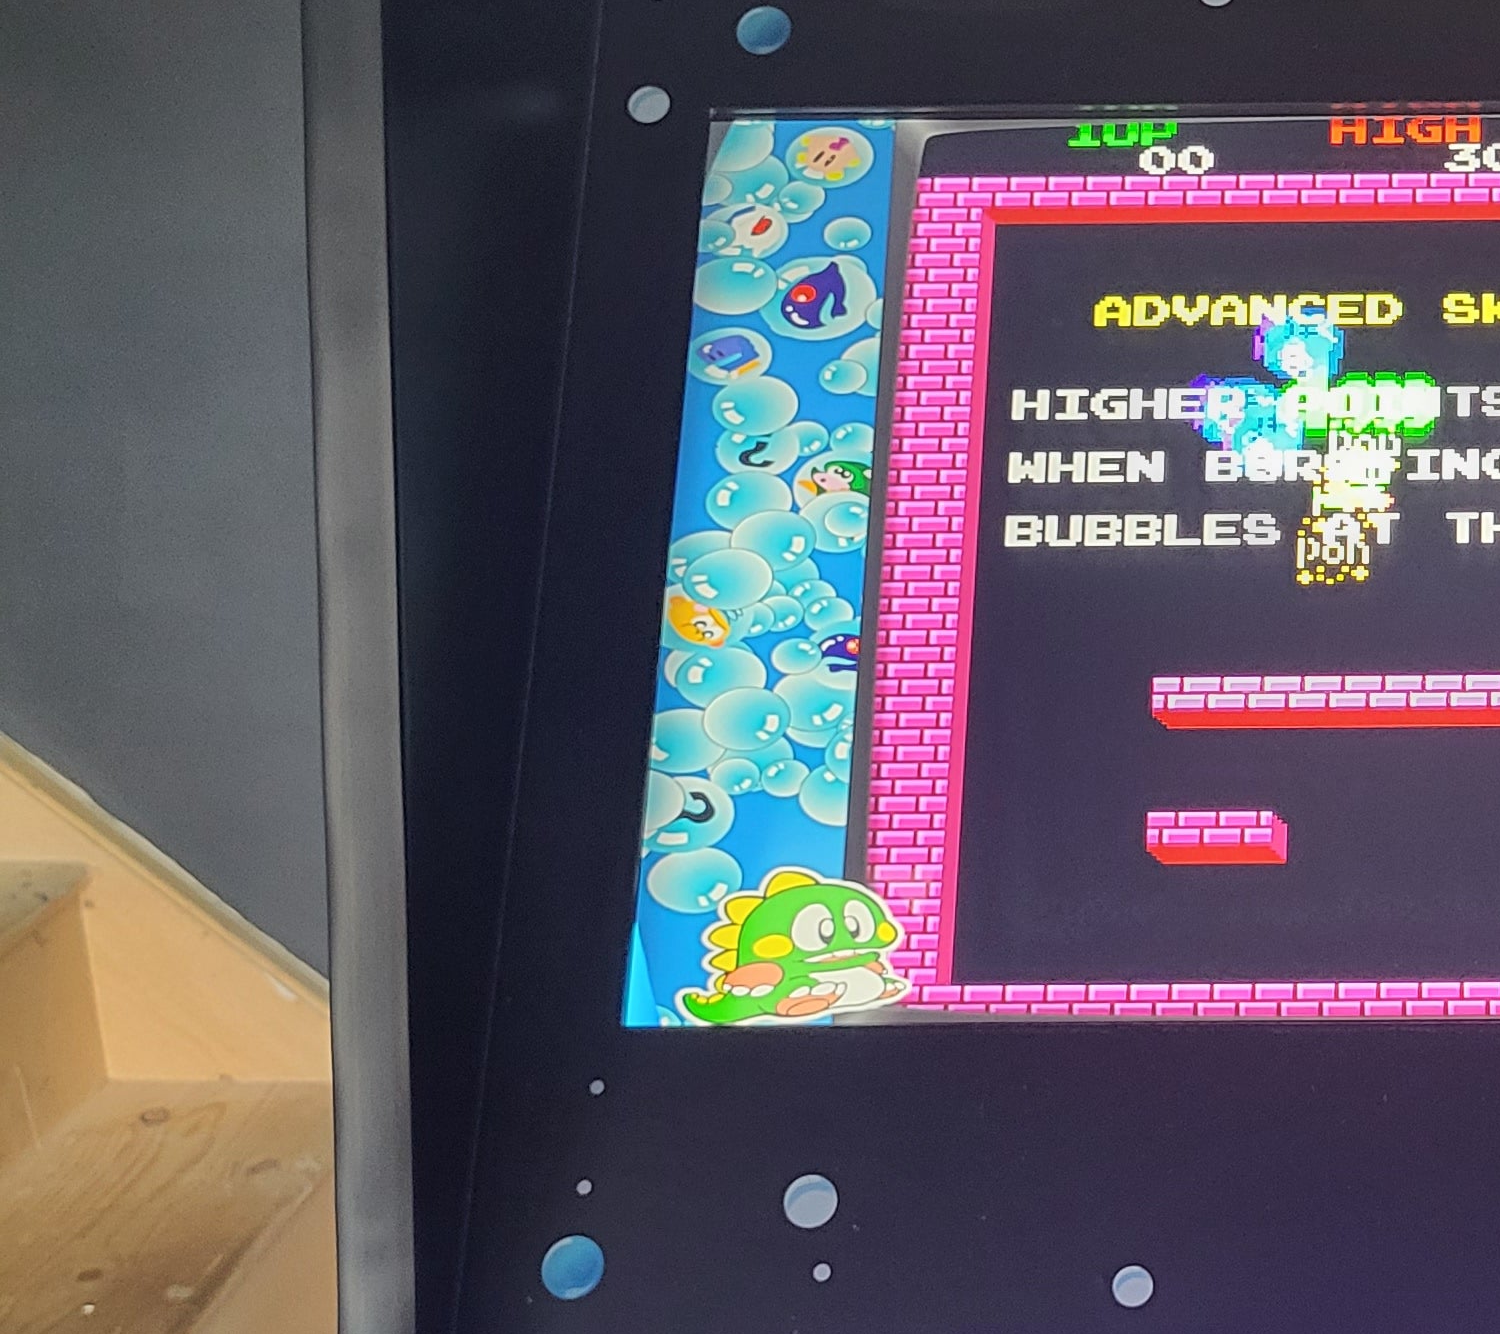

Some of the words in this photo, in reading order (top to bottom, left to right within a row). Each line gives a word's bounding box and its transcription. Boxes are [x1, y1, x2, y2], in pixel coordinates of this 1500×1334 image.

[1329, 116, 1482, 146] HIGH
[1093, 293, 1403, 327] ADVANCED
[1011, 386, 1246, 421] HIGHER
[1007, 450, 1166, 484] WHEN
[1004, 513, 1282, 548] BUBBLES
[1322, 512, 1400, 545] AT
